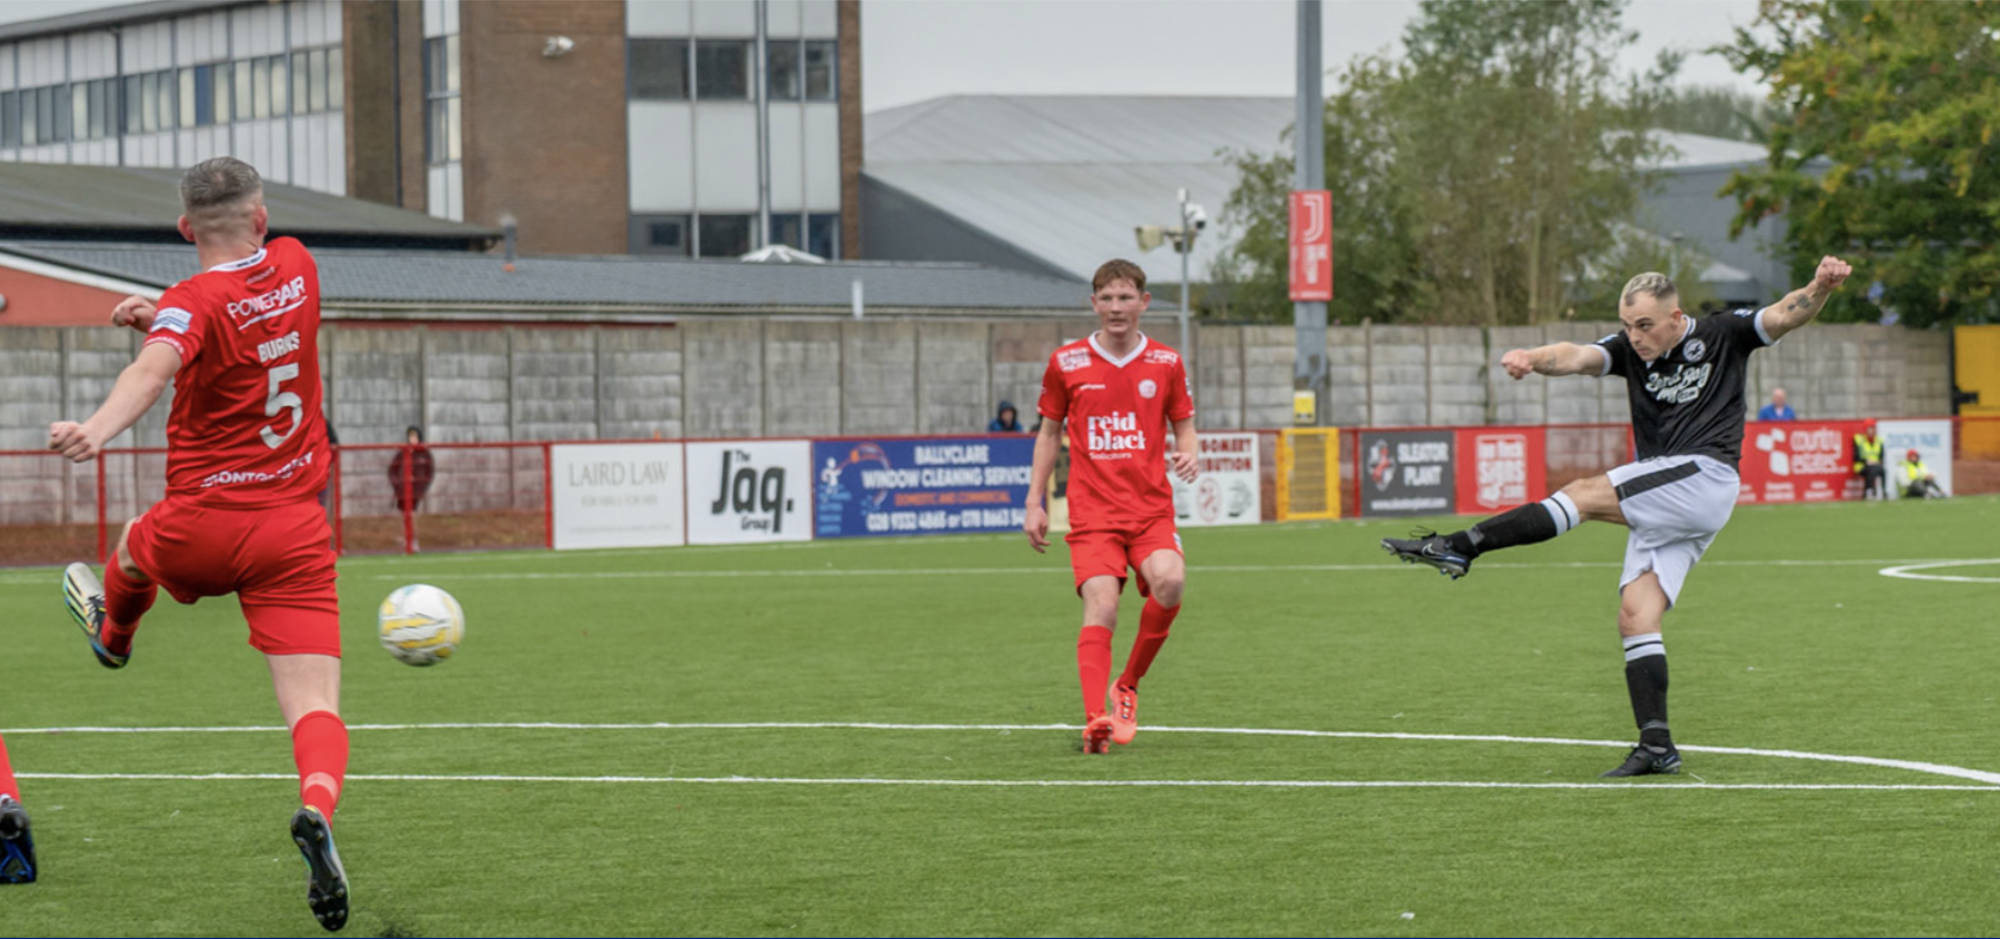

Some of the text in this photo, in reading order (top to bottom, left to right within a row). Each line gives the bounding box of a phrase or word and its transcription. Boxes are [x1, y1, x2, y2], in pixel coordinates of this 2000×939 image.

[227, 276, 306, 319] POWERAIR
[257, 330, 301, 363] BURNS
[259, 362, 303, 450] 5
[1087, 411, 1136, 431] reid
[1087, 430, 1146, 451] black
[736, 450, 751, 463] The
[914, 444, 989, 466] BALLYCLARE
[1397, 442, 1449, 464] SLEATOR
[568, 460, 669, 487] LAIRD LAW
[861, 468, 920, 490] WINDOW
[921, 466, 983, 488] CLEANING
[1404, 465, 1442, 487] PLANT
[741, 517, 770, 533] Group
[866, 511, 889, 532] 028
